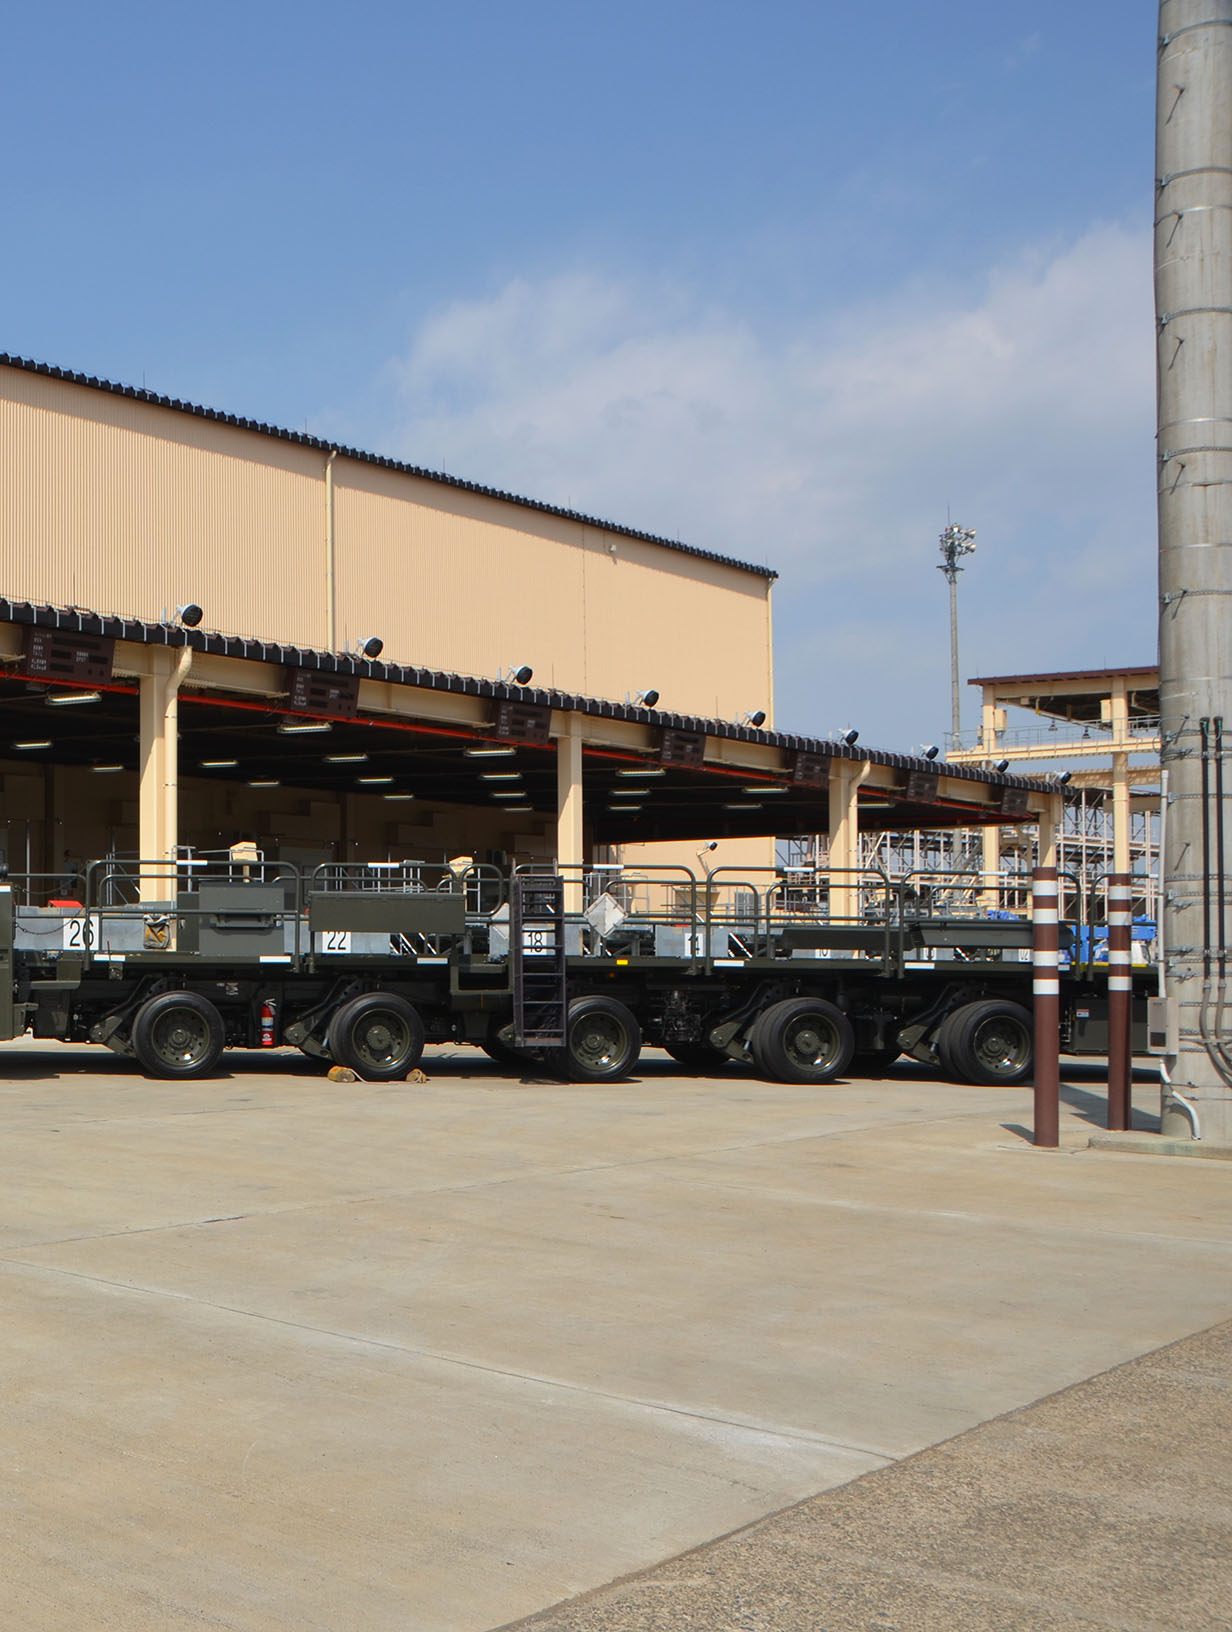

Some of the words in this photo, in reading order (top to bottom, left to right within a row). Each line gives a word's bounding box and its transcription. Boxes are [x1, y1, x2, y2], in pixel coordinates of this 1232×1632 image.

[70, 920, 94, 947] 26
[327, 931, 347, 950] 22
[528, 931, 542, 953] 18
